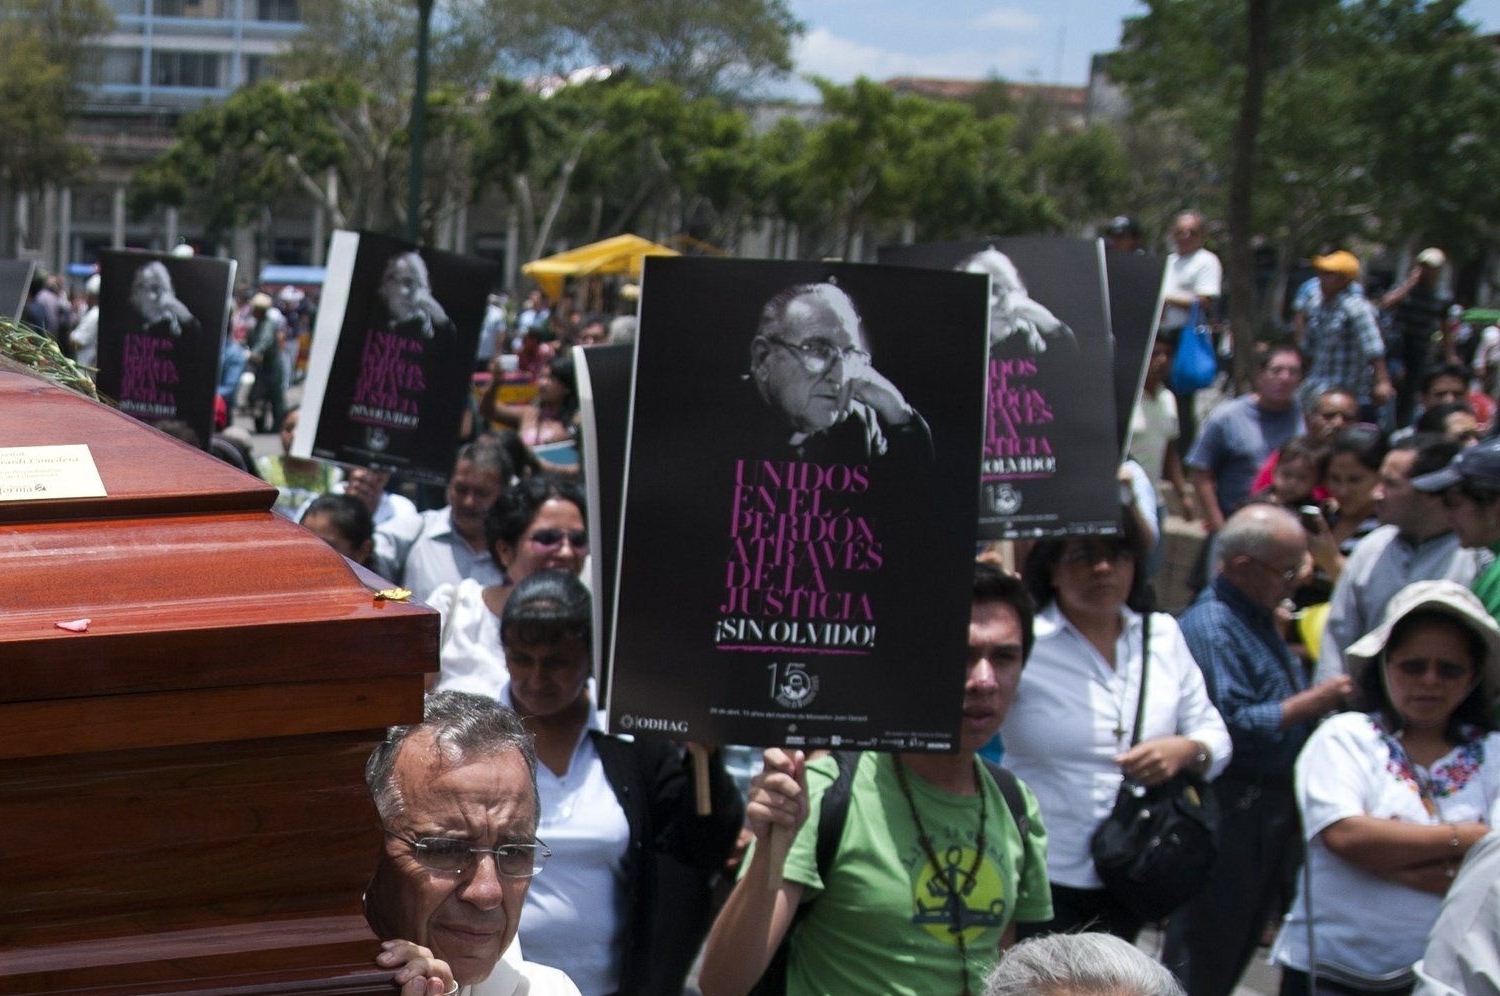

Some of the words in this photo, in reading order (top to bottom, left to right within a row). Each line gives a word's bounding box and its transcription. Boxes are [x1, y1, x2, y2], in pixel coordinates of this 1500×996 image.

[733, 459, 869, 493] UNIDOS
[733, 485, 779, 513] EN
[789, 488, 833, 517] EL
[731, 508, 877, 545] PERDÓN
[725, 561, 775, 590] DE
[784, 564, 827, 594] LA
[720, 587, 874, 621] JUSTICIA
[715, 618, 765, 643] ¡SIN
[769, 620, 877, 648] OLVIDO!
[638, 718, 689, 733] ODHAG
